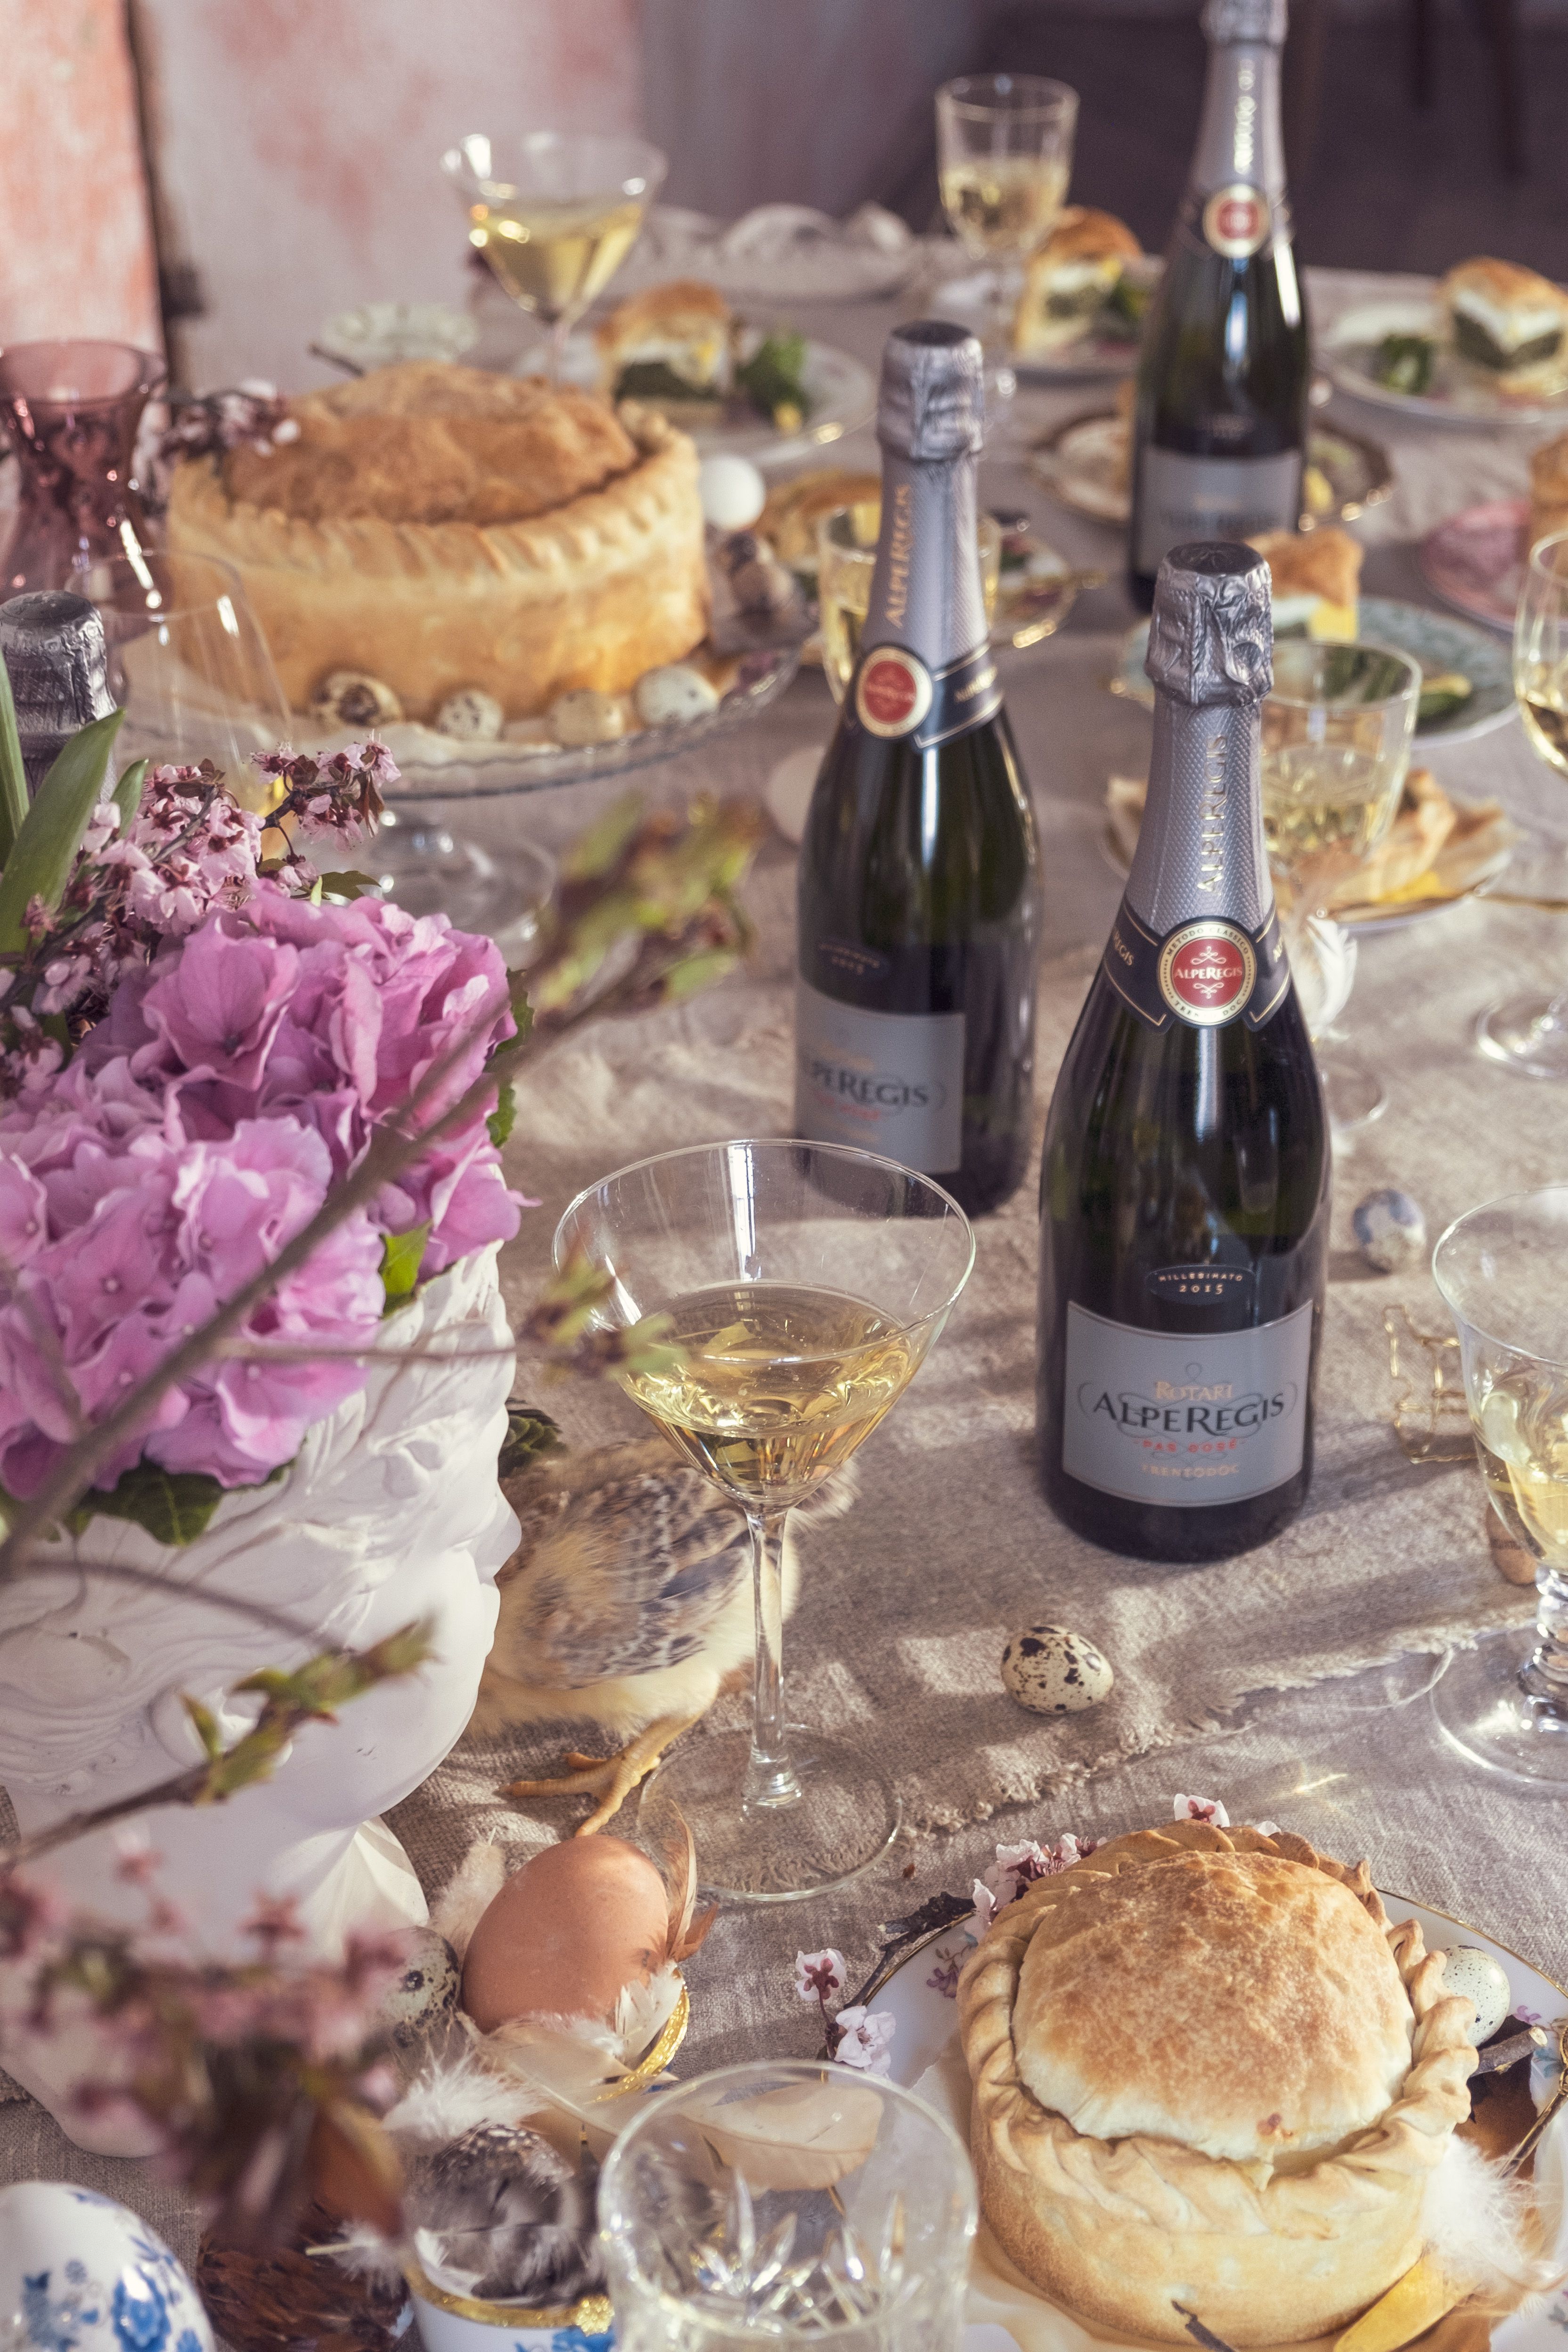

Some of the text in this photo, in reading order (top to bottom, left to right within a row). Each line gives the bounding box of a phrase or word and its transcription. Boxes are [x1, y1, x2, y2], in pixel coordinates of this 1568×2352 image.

[1197, 735, 1230, 896] ALPEREGIS
[1166, 928, 1204, 956] METODO
[1175, 967, 1243, 980] ALPEREGIS
[1158, 1272, 1243, 1282] MILLESIMATO
[1179, 1283, 1224, 1295] 2015
[1154, 1380, 1234, 1402] ROTARI
[1093, 1391, 1285, 1437] ALPEREGIS
[1142, 1439, 1177, 1453] PAS
[1141, 1463, 1240, 1478] TRENTODOC
